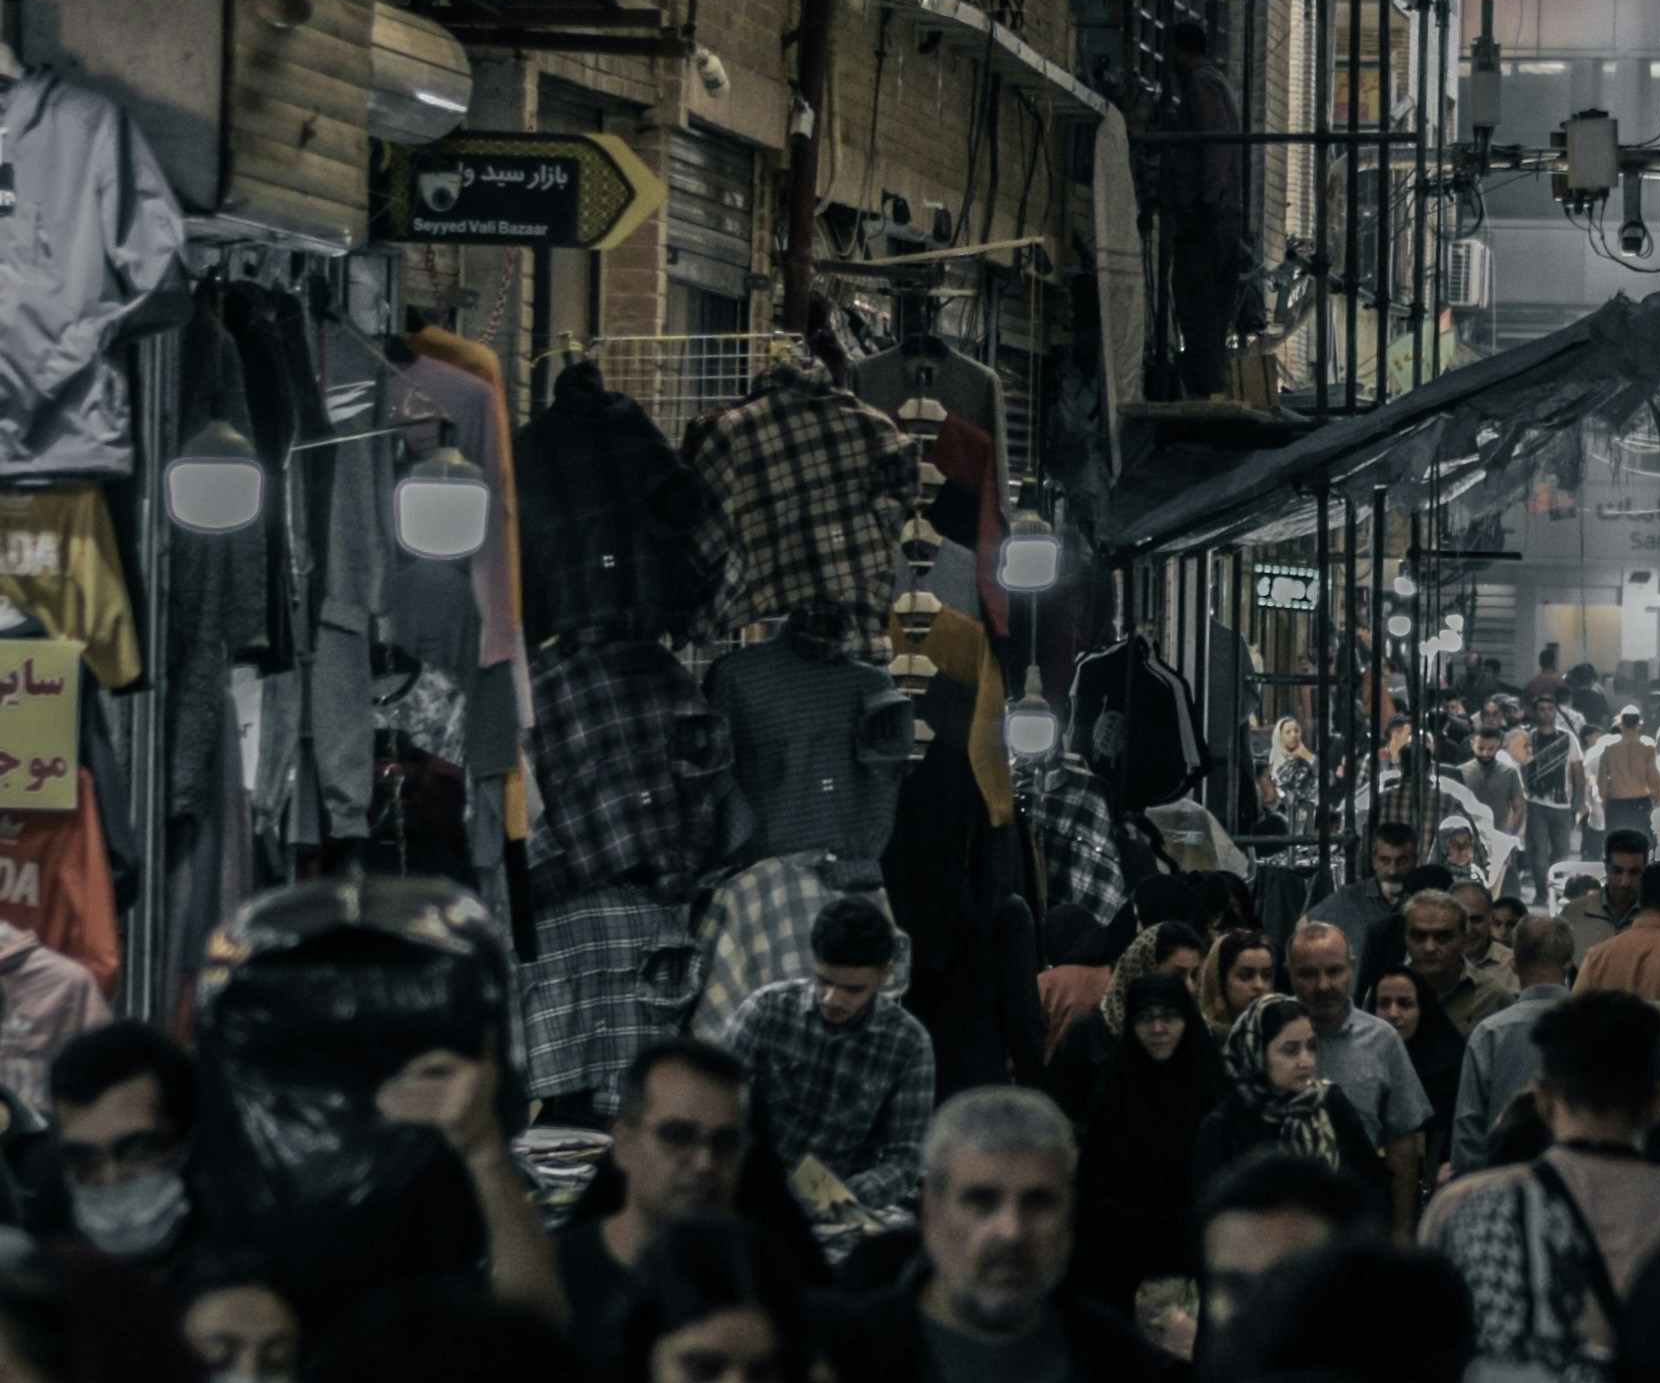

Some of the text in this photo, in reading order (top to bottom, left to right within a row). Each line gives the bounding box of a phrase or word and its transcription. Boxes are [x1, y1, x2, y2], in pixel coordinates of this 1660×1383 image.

[480, 164, 524, 187] سید
[525, 163, 569, 190] بازار
[413, 217, 549, 236] Seyyed Vali Bazaar
